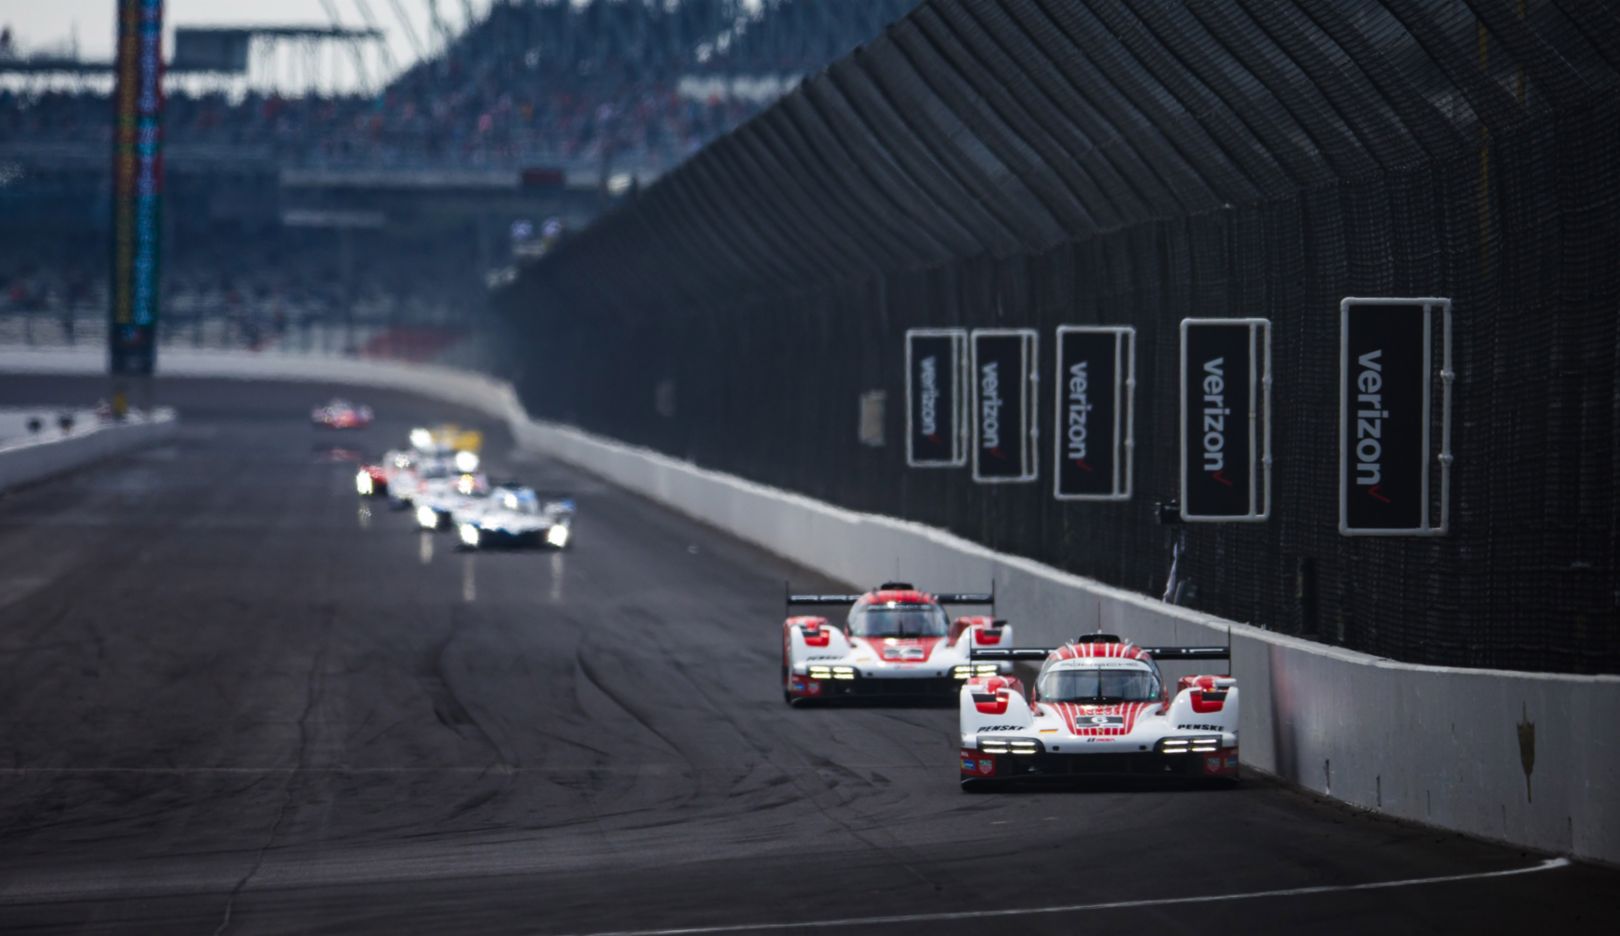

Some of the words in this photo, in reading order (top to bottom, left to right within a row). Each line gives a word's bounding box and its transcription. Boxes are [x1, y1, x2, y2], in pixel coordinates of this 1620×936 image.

[921, 356, 939, 435] verizon
[982, 362, 1002, 448] verizon
[1068, 361, 1092, 459] verizon
[1203, 357, 1231, 471] verizon
[1356, 349, 1389, 485] verizon
[1177, 724, 1224, 732] PENSKE
